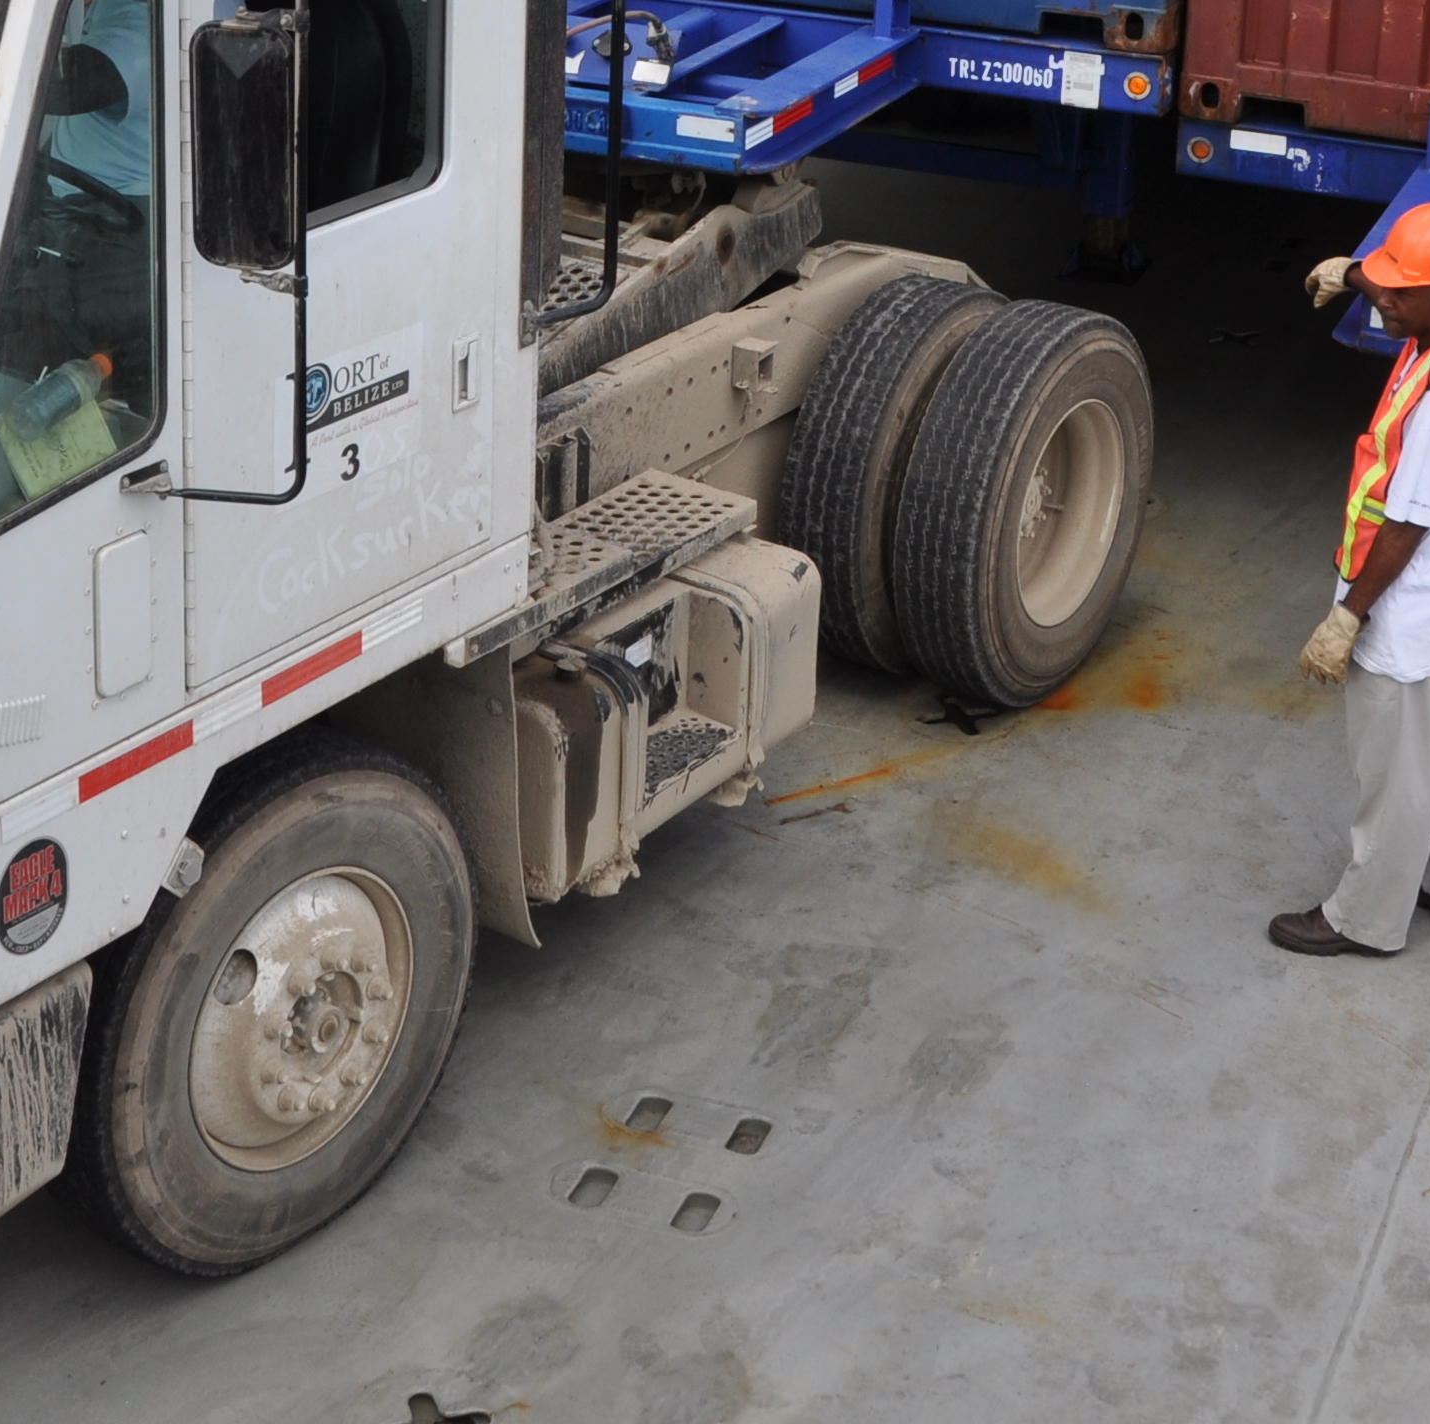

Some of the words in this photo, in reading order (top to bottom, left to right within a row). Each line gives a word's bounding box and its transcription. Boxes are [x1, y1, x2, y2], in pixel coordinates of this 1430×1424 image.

[379, 355, 390, 370] of
[333, 381, 390, 418] BELIZE
[391, 379, 404, 391] LTD
[340, 443, 360, 482] 3
[9, 844, 55, 894] EAGLE
[3, 876, 50, 924] MARK
[50, 869, 62, 898] 4
